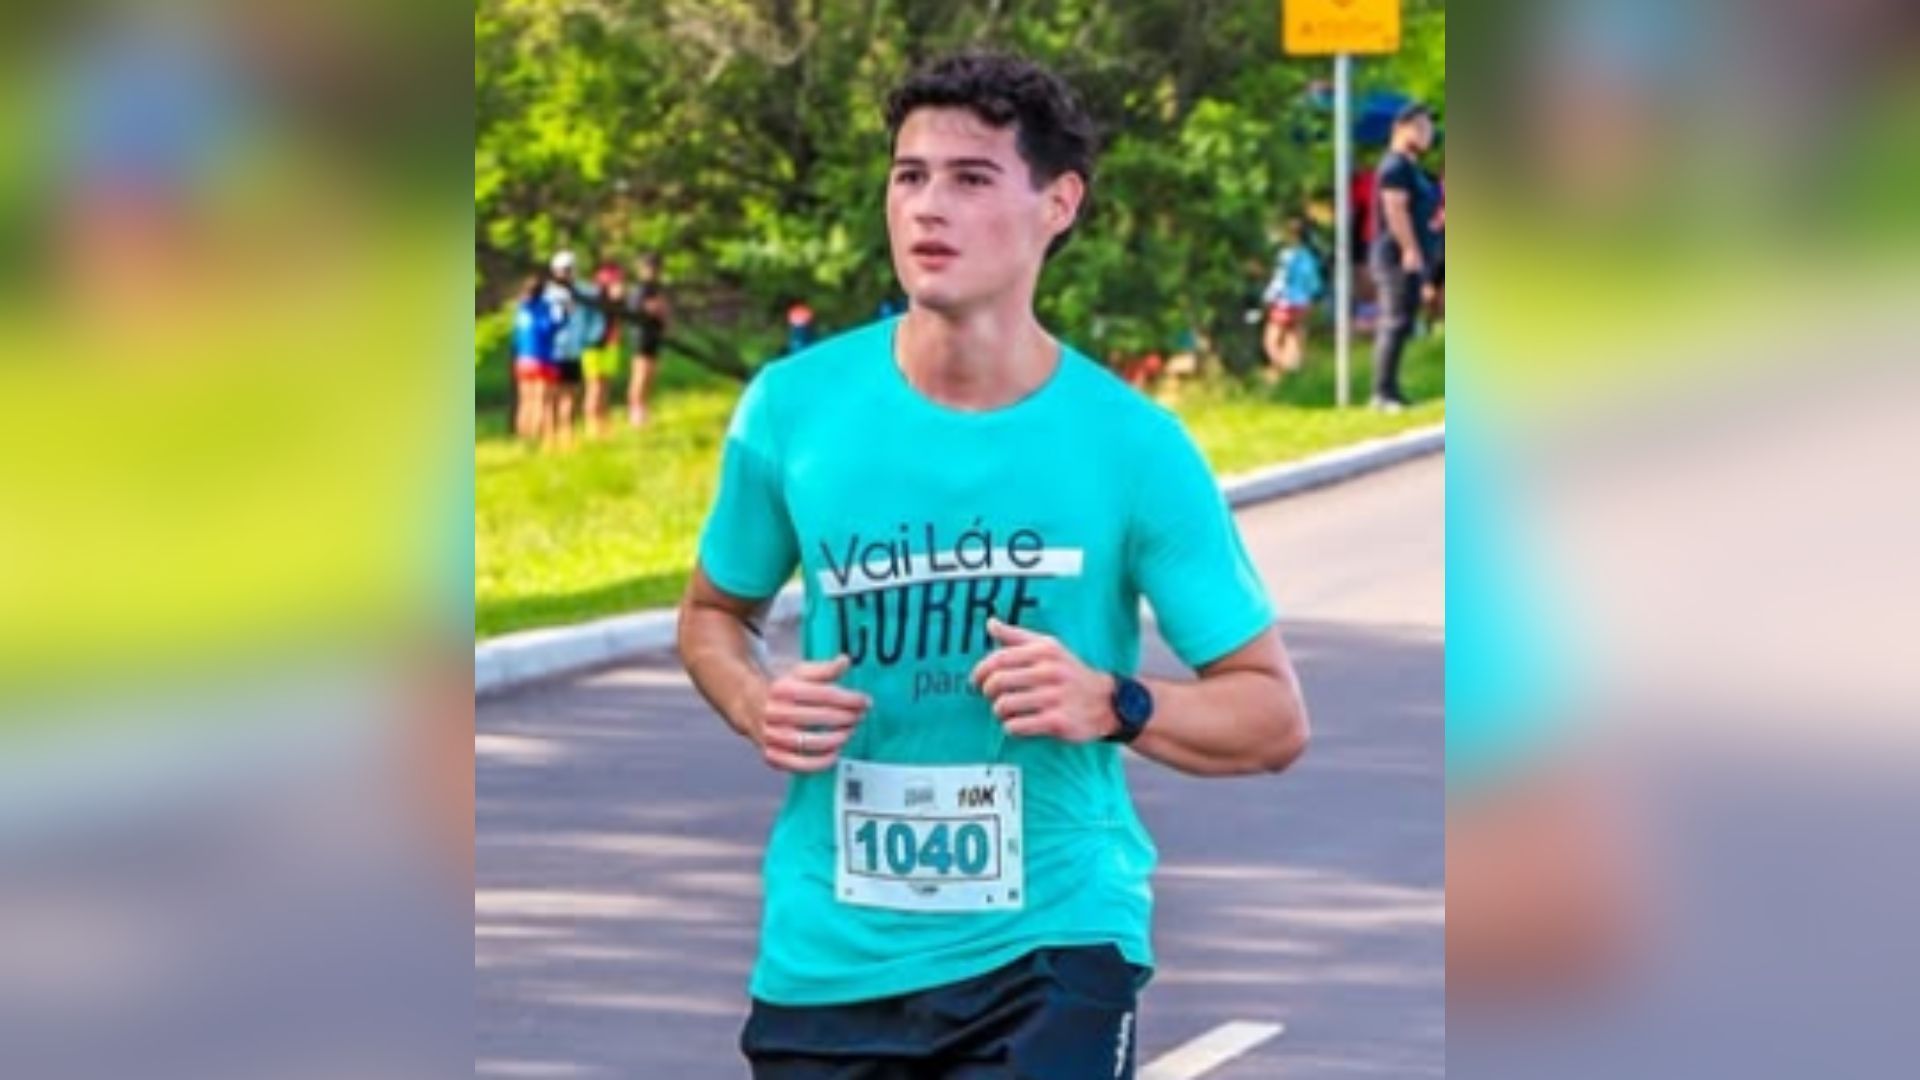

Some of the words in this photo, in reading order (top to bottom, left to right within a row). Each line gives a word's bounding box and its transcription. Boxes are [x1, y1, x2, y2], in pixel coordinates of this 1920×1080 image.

[820, 523, 911, 588] Vai
[925, 516, 991, 573] Lá
[1008, 529, 1045, 569] e
[957, 784, 996, 807] 10K
[855, 820, 989, 875] 1040
